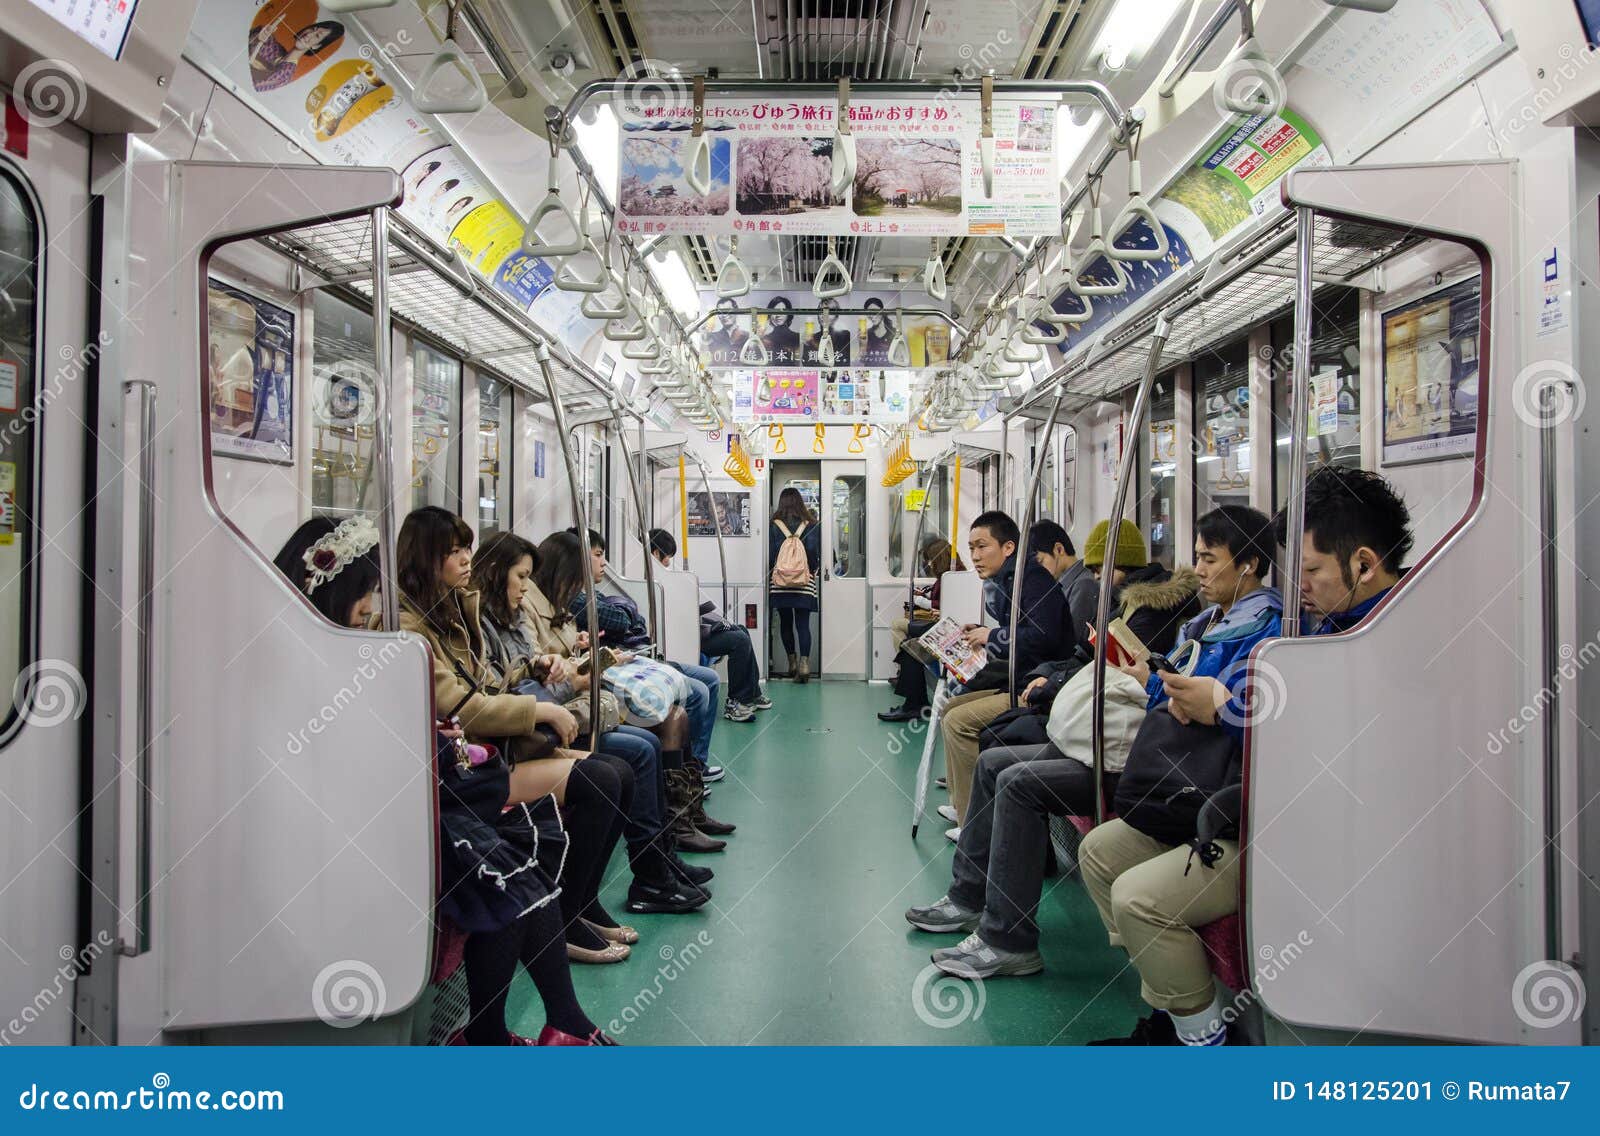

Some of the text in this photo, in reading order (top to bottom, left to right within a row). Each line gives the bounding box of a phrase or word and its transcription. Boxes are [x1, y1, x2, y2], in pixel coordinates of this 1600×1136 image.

[629, 220, 654, 232] 弘前
[745, 220, 770, 232] 角館
[861, 220, 887, 232] 北上
